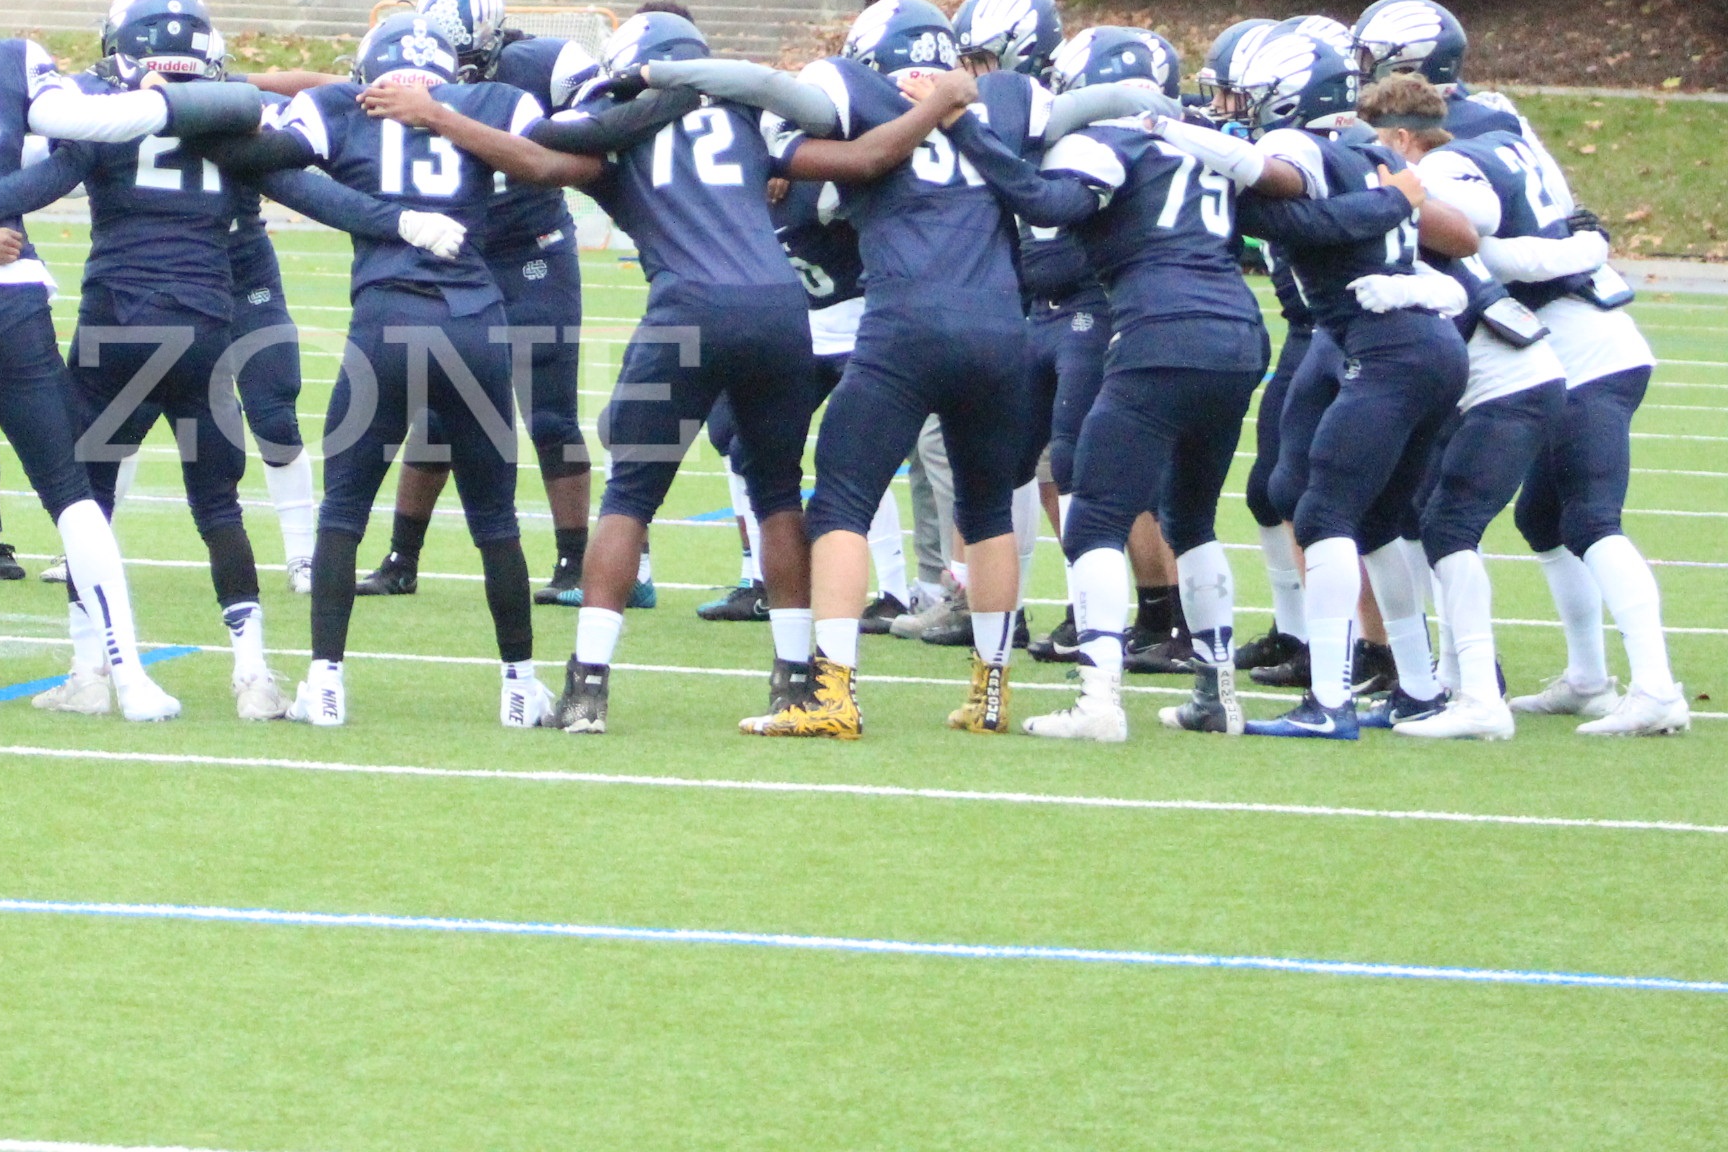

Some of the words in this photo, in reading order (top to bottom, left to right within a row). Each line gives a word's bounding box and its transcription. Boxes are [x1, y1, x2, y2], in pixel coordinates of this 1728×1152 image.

[145, 60, 198, 73] Riddell
[381, 104, 462, 197] 13
[321, 688, 339, 720] NIKE
[508, 691, 526, 725] NIKE
[985, 668, 1002, 723] ARMOUR
[1220, 669, 1240, 722] ARMOUR
